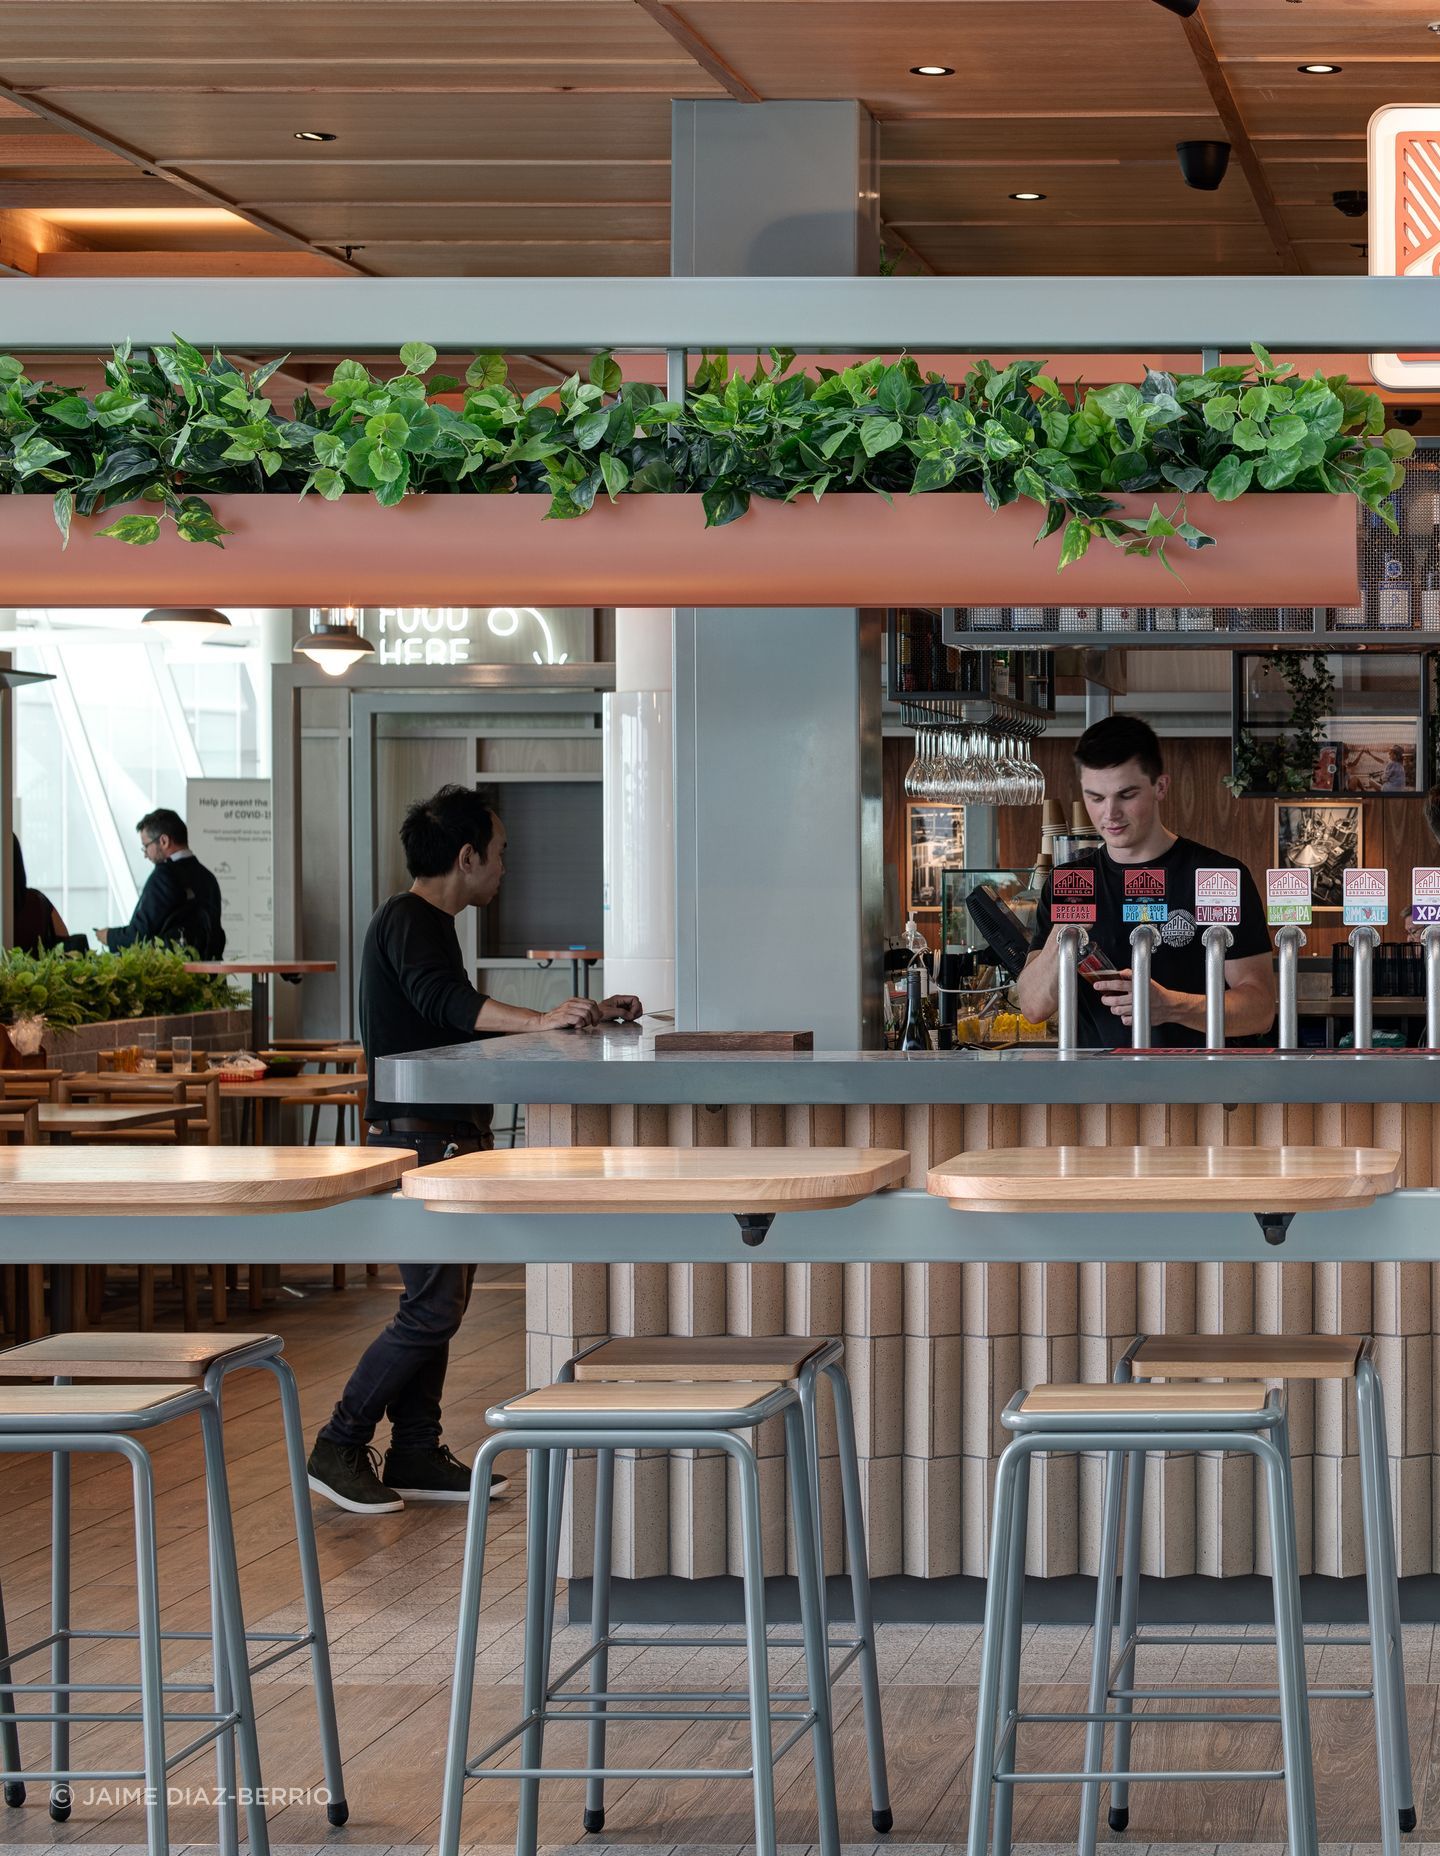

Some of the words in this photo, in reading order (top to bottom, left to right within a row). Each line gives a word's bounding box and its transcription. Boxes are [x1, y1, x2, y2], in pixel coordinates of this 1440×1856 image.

[379, 638, 470, 665] HERE
[199, 798, 219, 808] Help
[220, 798, 253, 808] prevent
[254, 798, 268, 807] the
[224, 810, 233, 819] of
[1058, 872, 1091, 888] CAPITAL
[1128, 872, 1162, 888] CAPITAL
[1202, 873, 1234, 889] CAPITAL
[1272, 873, 1305, 889] CAPITAL
[1349, 873, 1382, 889] CAPITAL
[1149, 912, 1164, 920] ALE
[1197, 906, 1214, 921] EVIL
[1223, 906, 1237, 914] RED
[1296, 906, 1310, 921] IPA
[1371, 910, 1386, 922] ALE
[1163, 916, 1194, 930] CAPITAL
